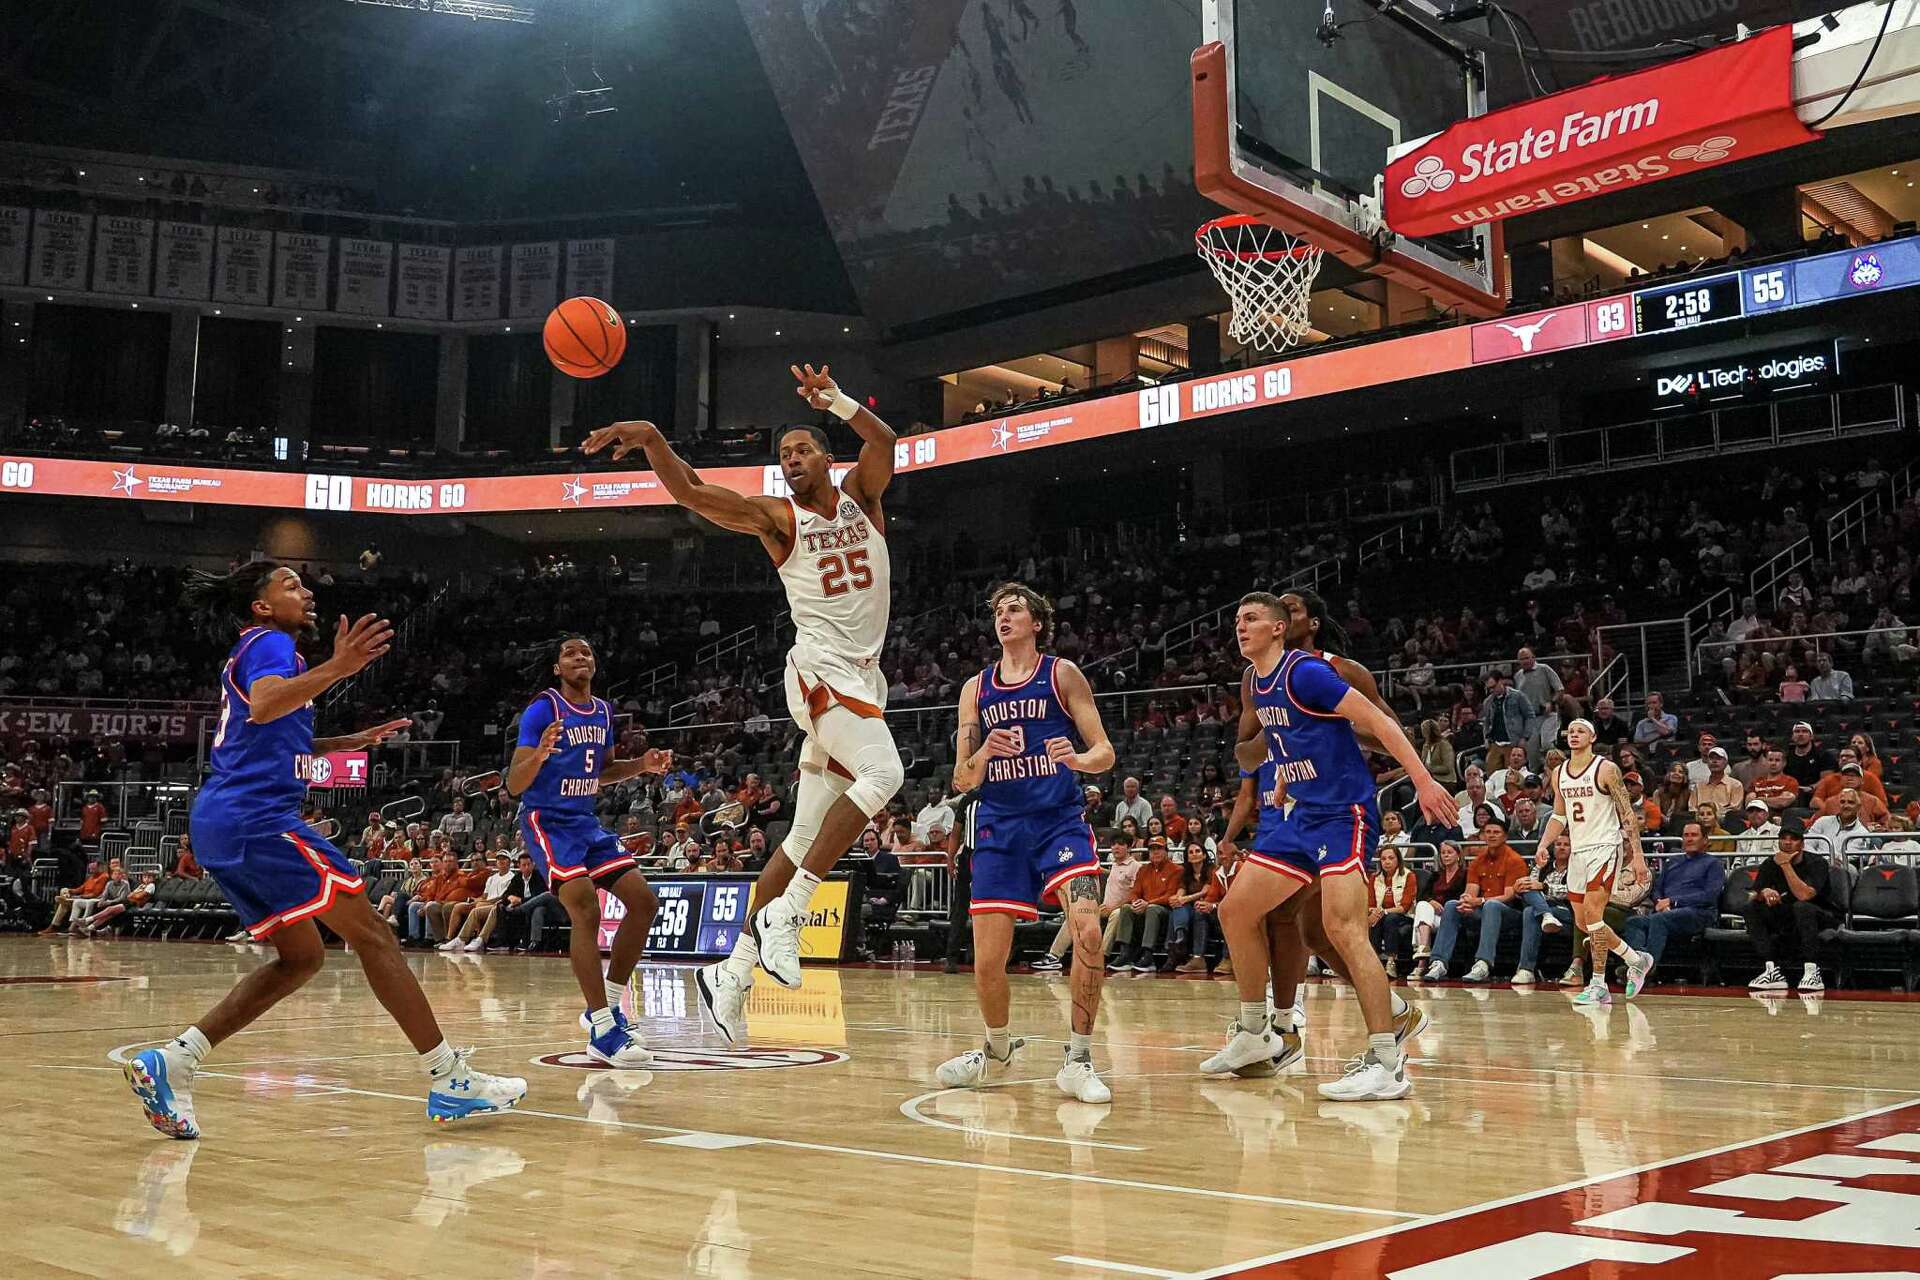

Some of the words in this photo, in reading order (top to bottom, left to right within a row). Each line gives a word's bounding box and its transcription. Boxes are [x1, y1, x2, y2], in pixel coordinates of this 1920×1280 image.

[1753, 271, 1785, 303] 55
[1597, 303, 1625, 333] 83
[1665, 289, 1711, 319] 2:58
[1139, 383, 1180, 429] GO
[1192, 374, 1256, 413] HORNS
[1264, 367, 1292, 399] GO
[915, 438, 936, 463] GO
[2, 461, 34, 488] GO
[306, 474, 352, 510] GO
[366, 483, 433, 509] HORNS
[440, 484, 465, 508] GO
[804, 520, 869, 554] TEXAS
[817, 547, 874, 598] 25
[981, 699, 1047, 729] HOUSTON
[566, 725, 606, 747] HOUSTON
[346, 759, 365, 780] T
[584, 749, 595, 773] 5
[988, 755, 1058, 782] CHRISTIAN
[1561, 786, 1594, 799] TEXAS
[1572, 801, 1585, 822] 2
[649, 899, 689, 936] :58
[712, 886, 739, 921] 55
